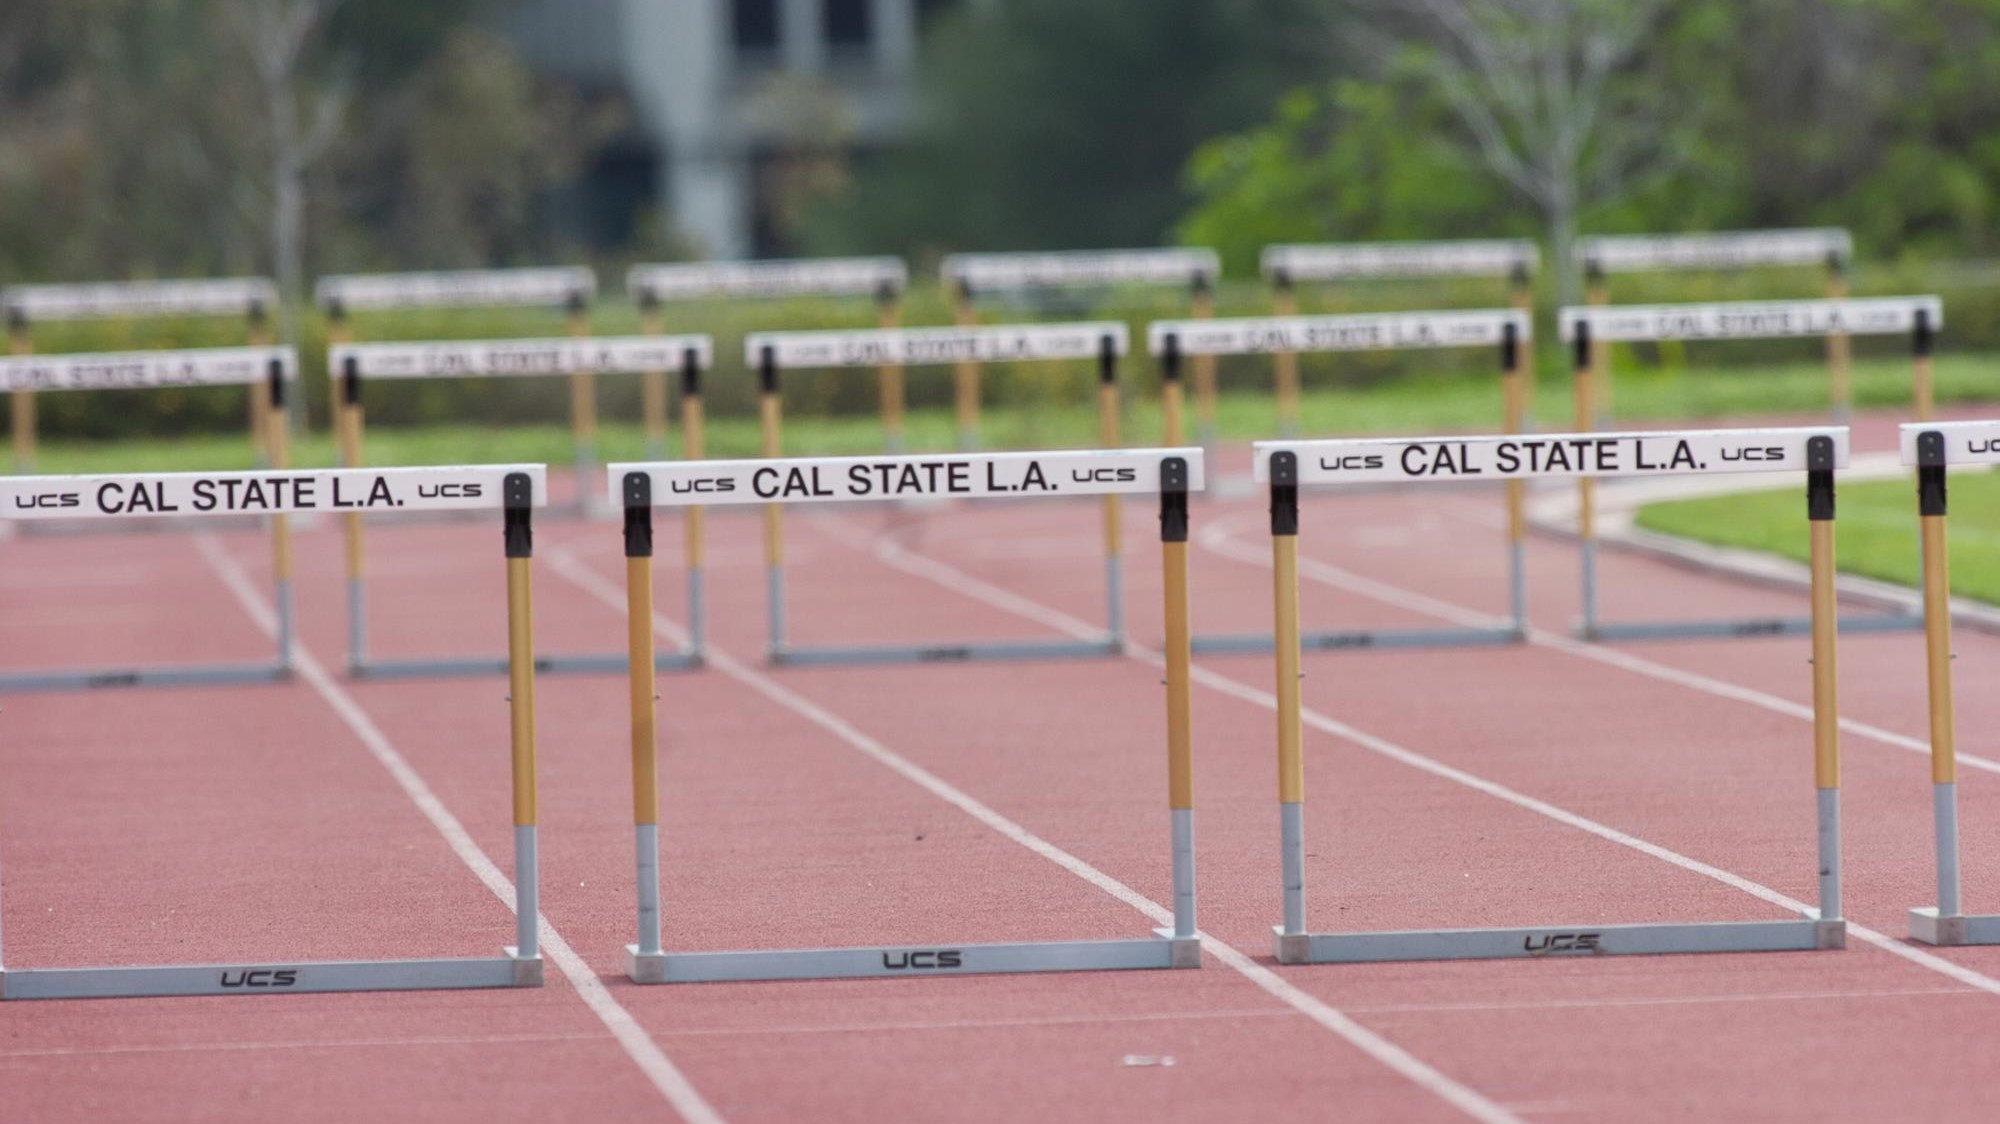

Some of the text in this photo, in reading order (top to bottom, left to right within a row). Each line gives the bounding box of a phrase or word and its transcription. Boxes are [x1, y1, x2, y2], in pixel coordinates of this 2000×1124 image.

[1320, 439, 1785, 476] UCS CAL STATE L.A. UCS
[671, 460, 1136, 499] UCS CAL STATE L.A. UCS
[15, 476, 482, 515] UCS CAL STATE L.A. UCS
[1523, 933, 1601, 952] UCS
[882, 950, 962, 970] UCS
[220, 969, 298, 988] UCS
